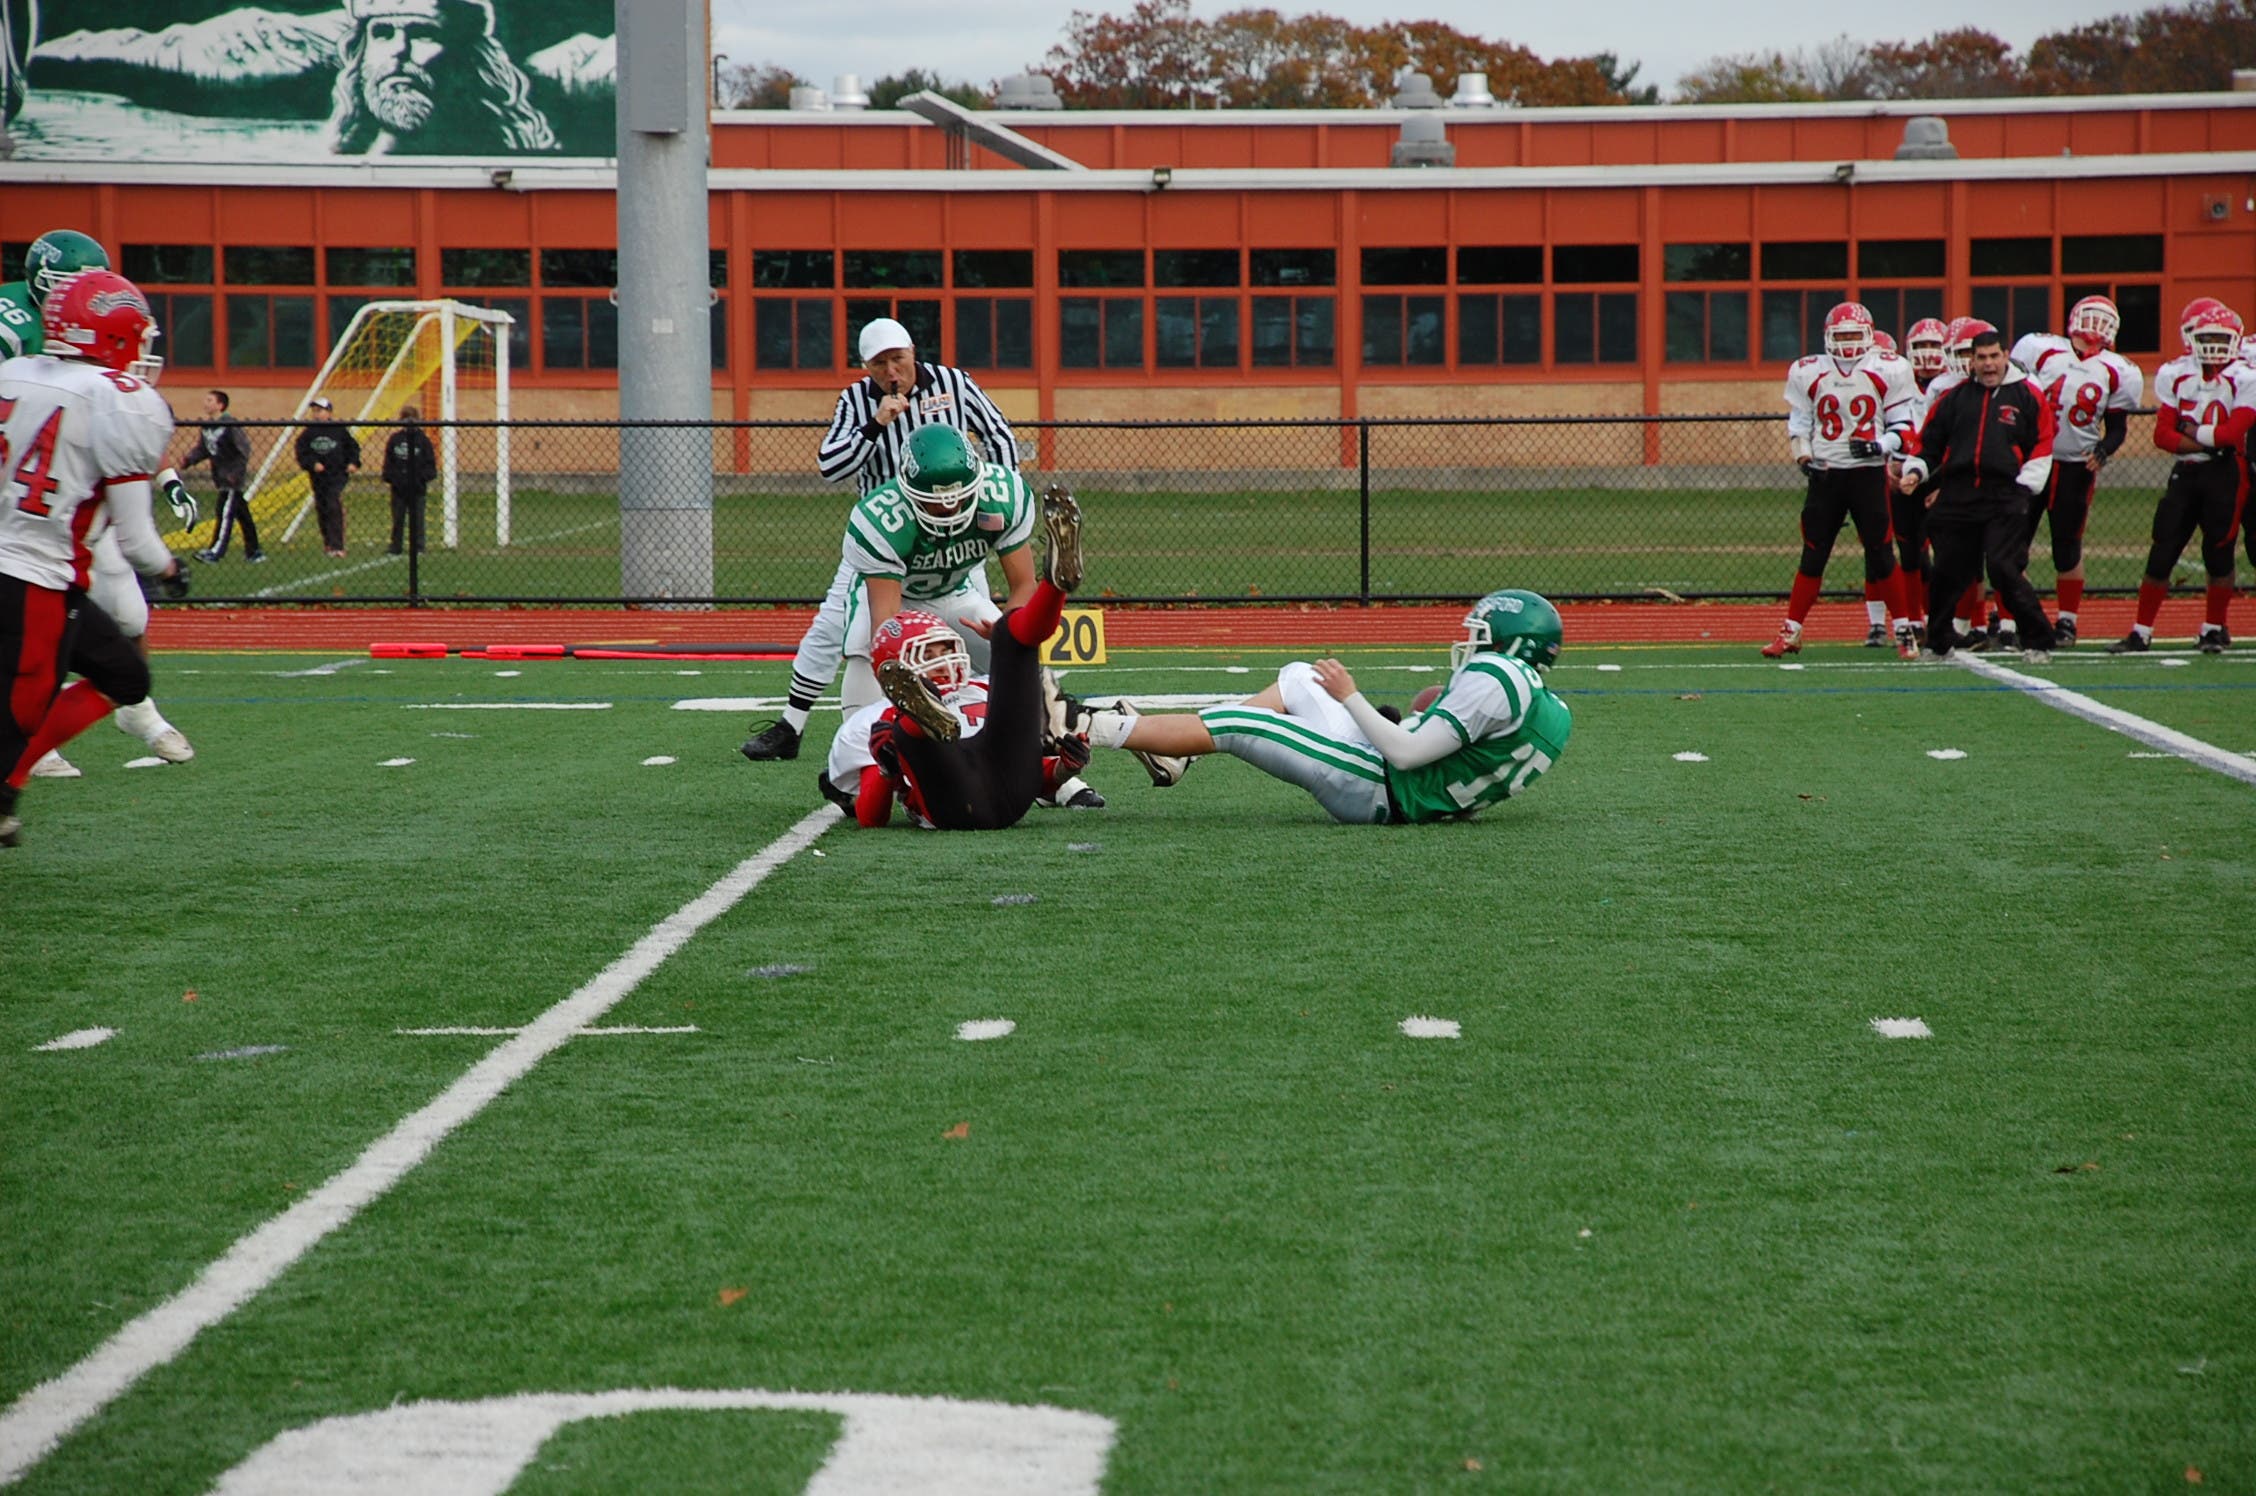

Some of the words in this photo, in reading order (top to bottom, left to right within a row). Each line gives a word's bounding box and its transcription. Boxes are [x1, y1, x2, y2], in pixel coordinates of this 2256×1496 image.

[1817, 394, 1877, 441] 62
[865, 488, 916, 534] 25
[910, 537, 990, 571] SEAFORD
[1051, 615, 1099, 661] 20
